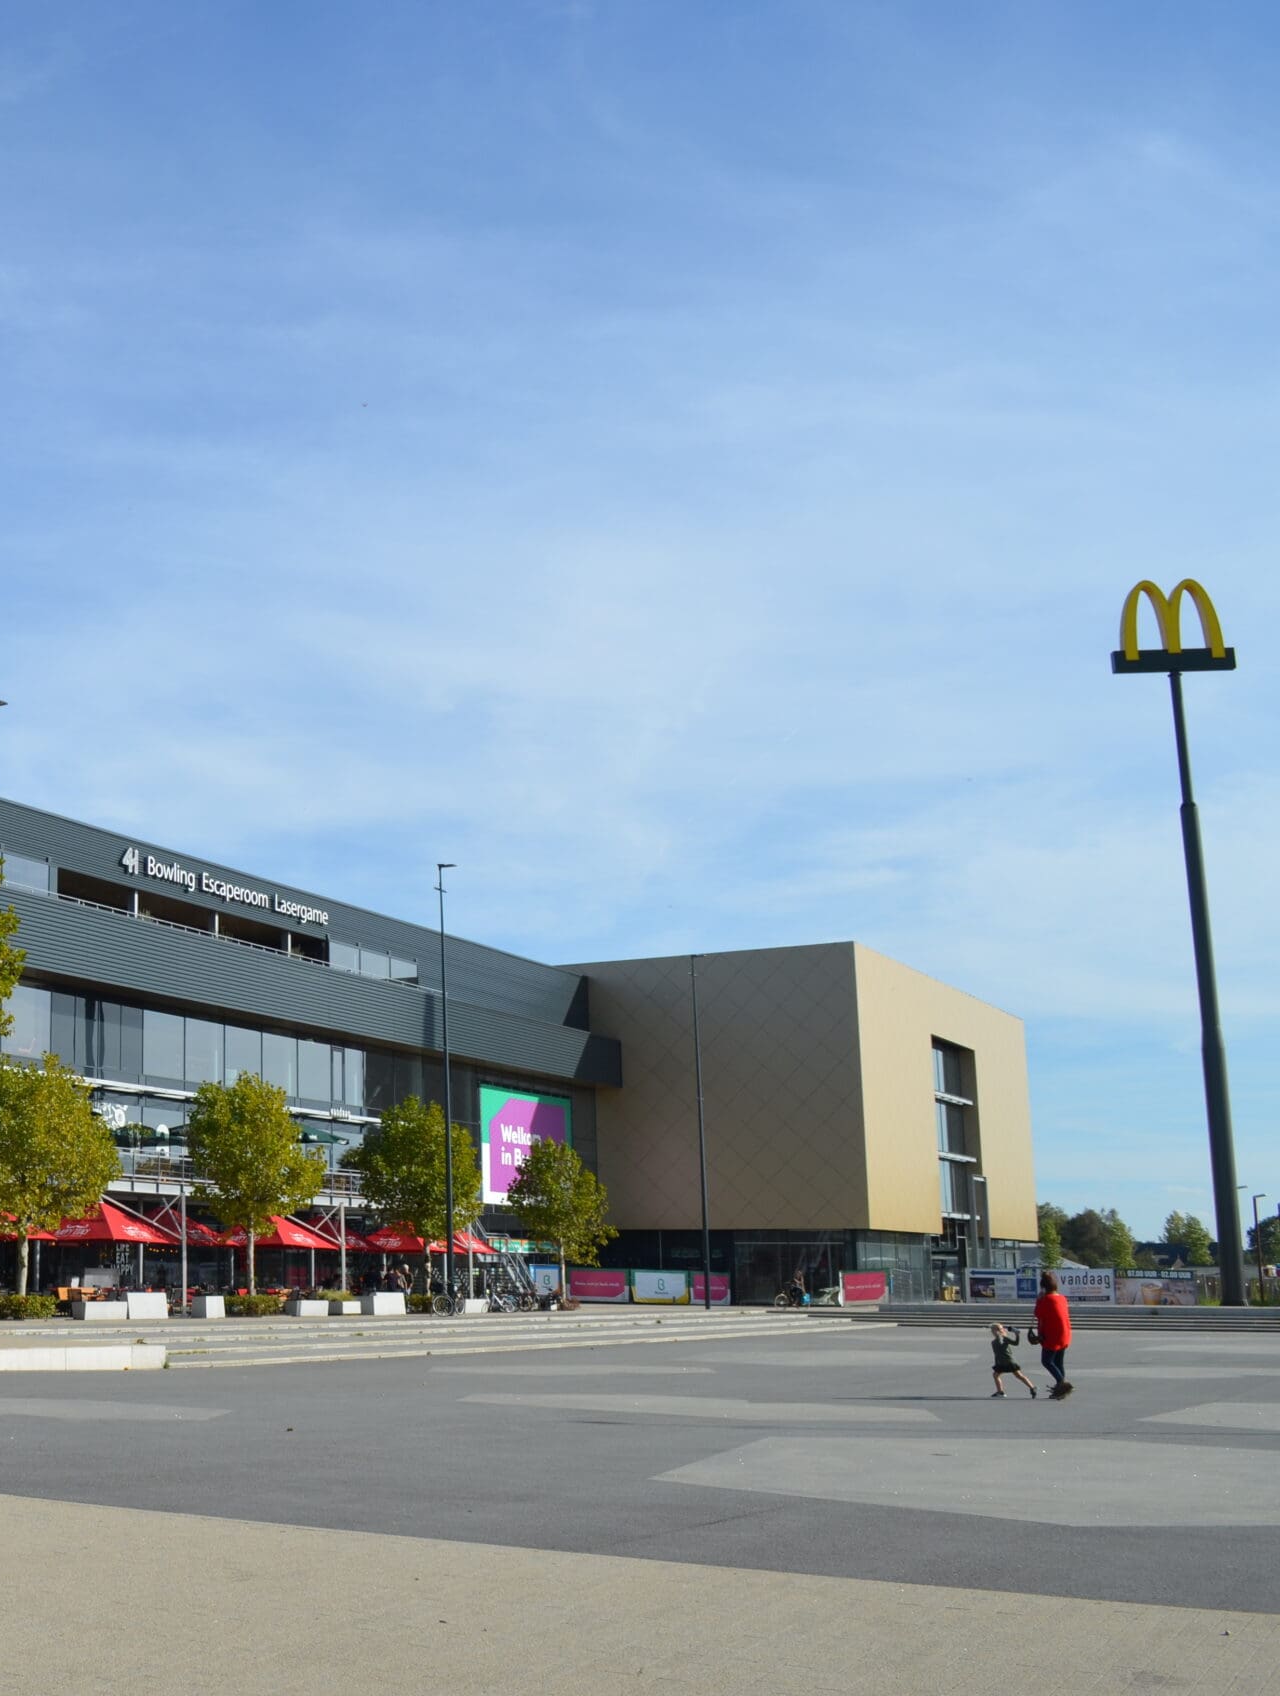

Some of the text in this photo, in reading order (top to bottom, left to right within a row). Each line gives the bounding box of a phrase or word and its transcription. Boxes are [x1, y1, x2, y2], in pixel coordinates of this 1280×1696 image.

[147, 856, 196, 892] Bowling
[202, 872, 269, 909] Escaperoom
[274, 893, 329, 925] Lasergame
[500, 1123, 542, 1149] Welkom
[501, 1146, 512, 1165] in
[116, 1253, 129, 1264] EAT
[1060, 1272, 1111, 1288] vandaag
